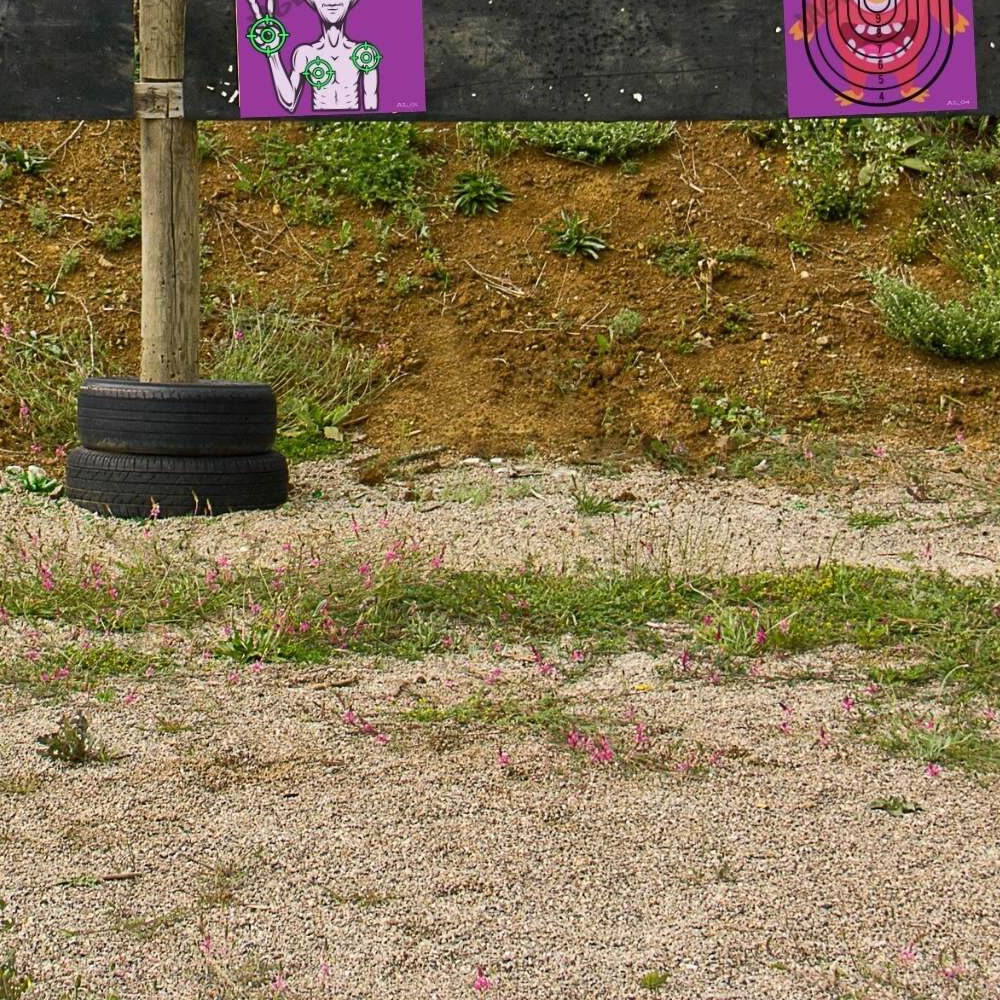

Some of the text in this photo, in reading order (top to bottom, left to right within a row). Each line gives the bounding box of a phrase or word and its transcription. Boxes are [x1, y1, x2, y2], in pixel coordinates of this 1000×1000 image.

[875, 13, 881, 23] 9
[877, 44, 882, 53] 7
[878, 59, 884, 69] 6
[878, 74, 884, 84] 5
[879, 91, 885, 101] 4
